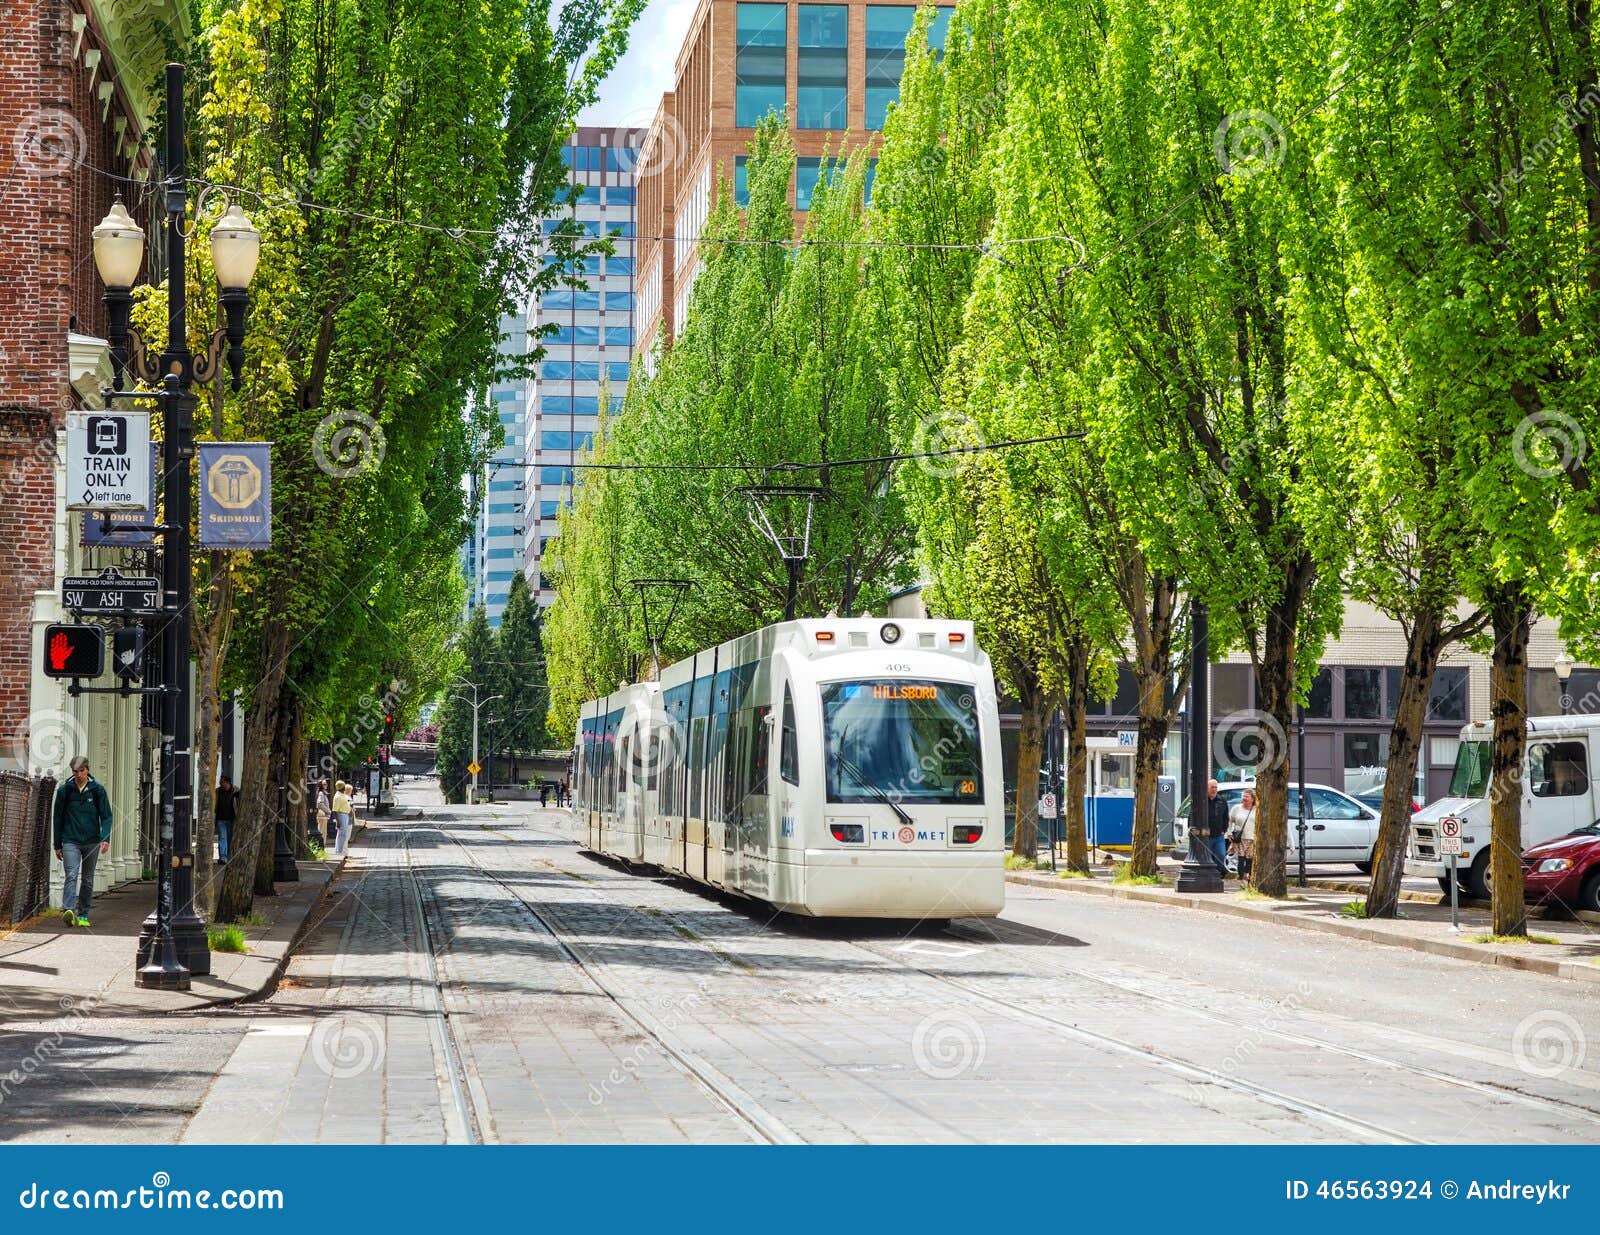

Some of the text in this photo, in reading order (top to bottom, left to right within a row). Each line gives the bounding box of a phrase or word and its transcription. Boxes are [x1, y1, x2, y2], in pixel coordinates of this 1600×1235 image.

[83, 457, 131, 471] TRAIN
[86, 473, 127, 487] ONLY
[95, 492, 132, 501] left lane
[92, 511, 145, 522] SKDMORE
[209, 512, 262, 523] SKIDMORE
[66, 591, 157, 607] SW ASH ST
[885, 663, 911, 672] 405
[873, 685, 937, 700] HILLSBORO
[1120, 733, 1135, 745] PAY
[961, 780, 975, 794] 20
[781, 816, 795, 838] MAX
